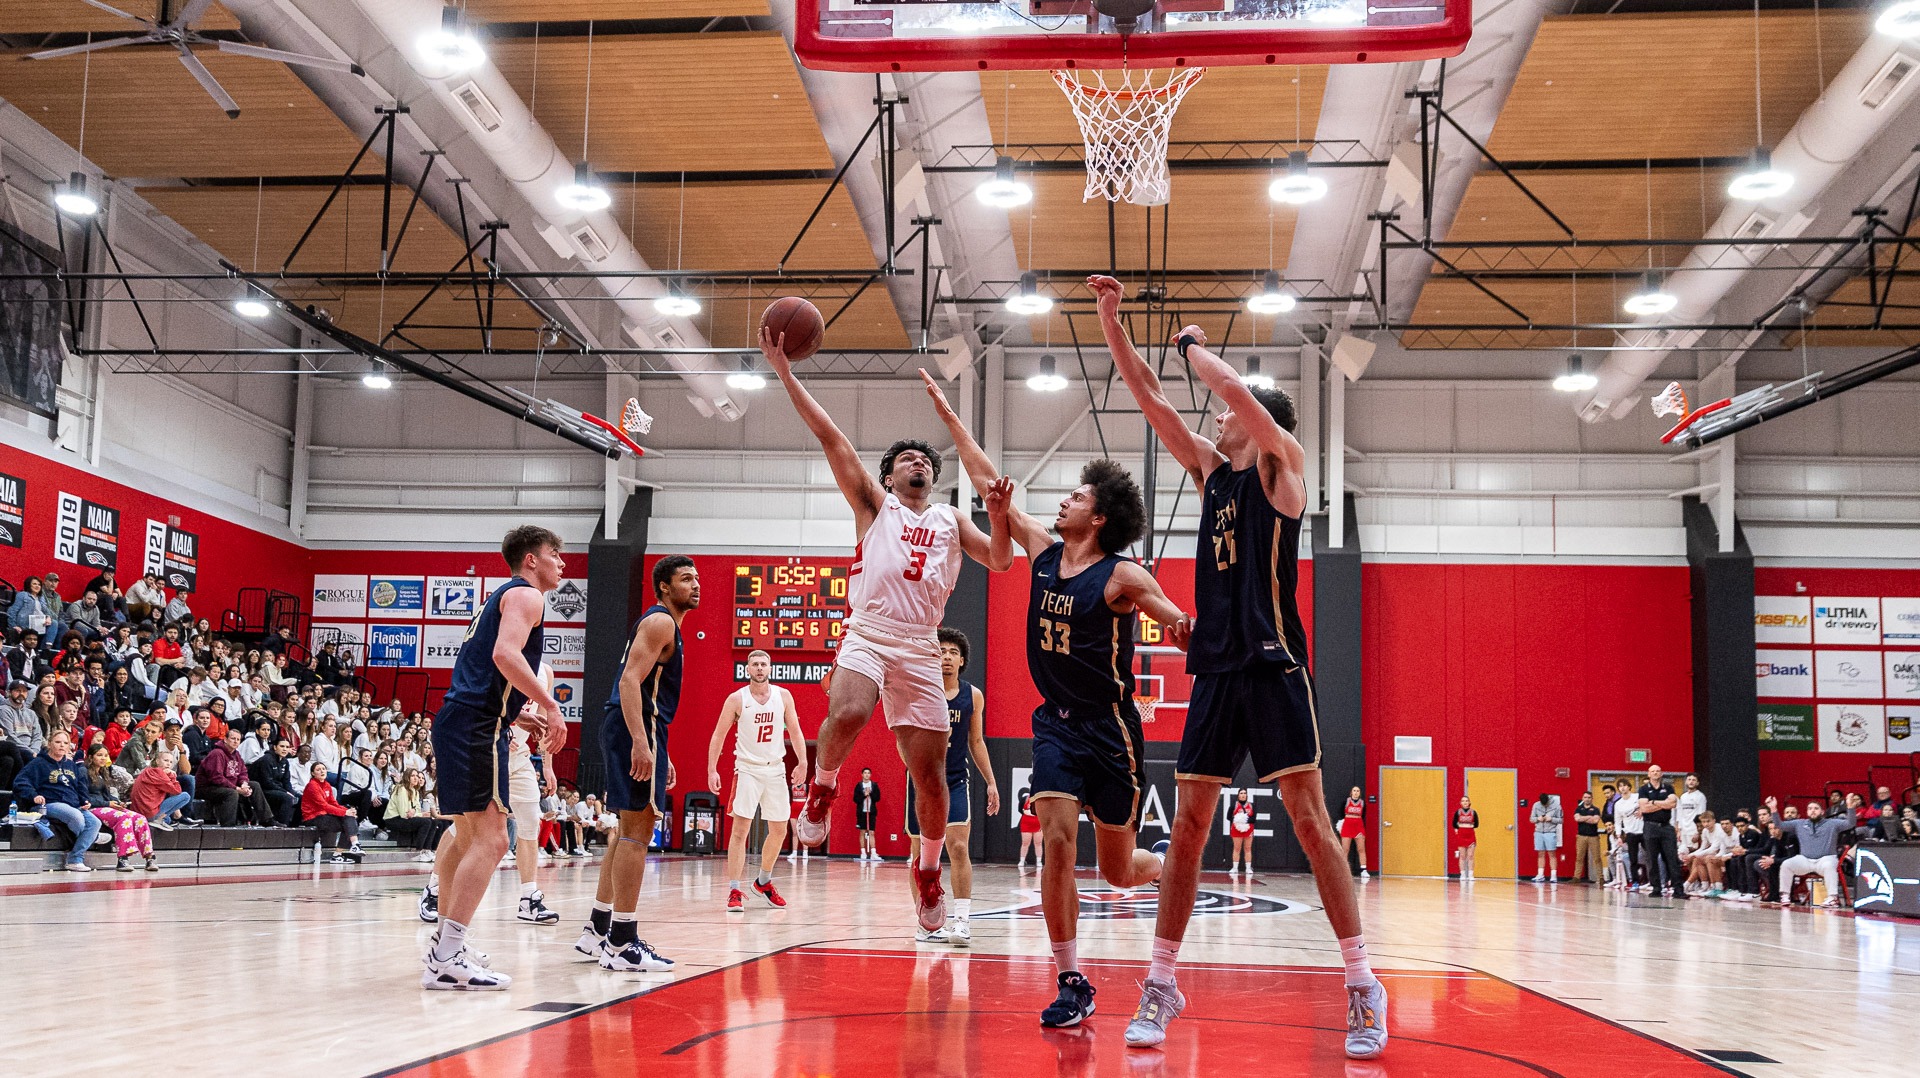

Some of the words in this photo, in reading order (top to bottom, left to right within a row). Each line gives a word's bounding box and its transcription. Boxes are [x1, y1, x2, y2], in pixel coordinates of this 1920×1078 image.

[0, 477, 17, 505] AIA
[87, 505, 113, 534] NAIA
[60, 498, 77, 558] 2019
[900, 524, 936, 548] SOU
[171, 531, 193, 557] NAIA
[902, 549, 928, 582] 3
[774, 567, 816, 585] 15:52
[327, 589, 365, 598] ROGUE
[751, 577, 762, 597] 3
[831, 579, 846, 598] 10
[434, 588, 468, 610] 12
[780, 596, 802, 606] period
[812, 594, 817, 607] 1
[1041, 589, 1075, 616] TECH
[737, 609, 754, 617] fouls
[779, 609, 802, 619] player
[827, 611, 844, 619] fouls
[1827, 607, 1868, 618] LITHIA
[742, 621, 751, 635] 2
[760, 621, 769, 636] 6
[811, 622, 820, 637] 6
[832, 623, 842, 637] 0
[1141, 620, 1161, 643] 16
[1825, 619, 1878, 630] driveway
[372, 631, 416, 647] Flagship
[781, 640, 799, 648] game
[1039, 617, 1071, 656] 33
[385, 645, 402, 658] Inn
[427, 646, 461, 657] PIZZ
[1893, 663, 1915, 673] OAK
[754, 712, 774, 724] SOU
[949, 709, 961, 723] CH
[756, 725, 774, 743] 12
